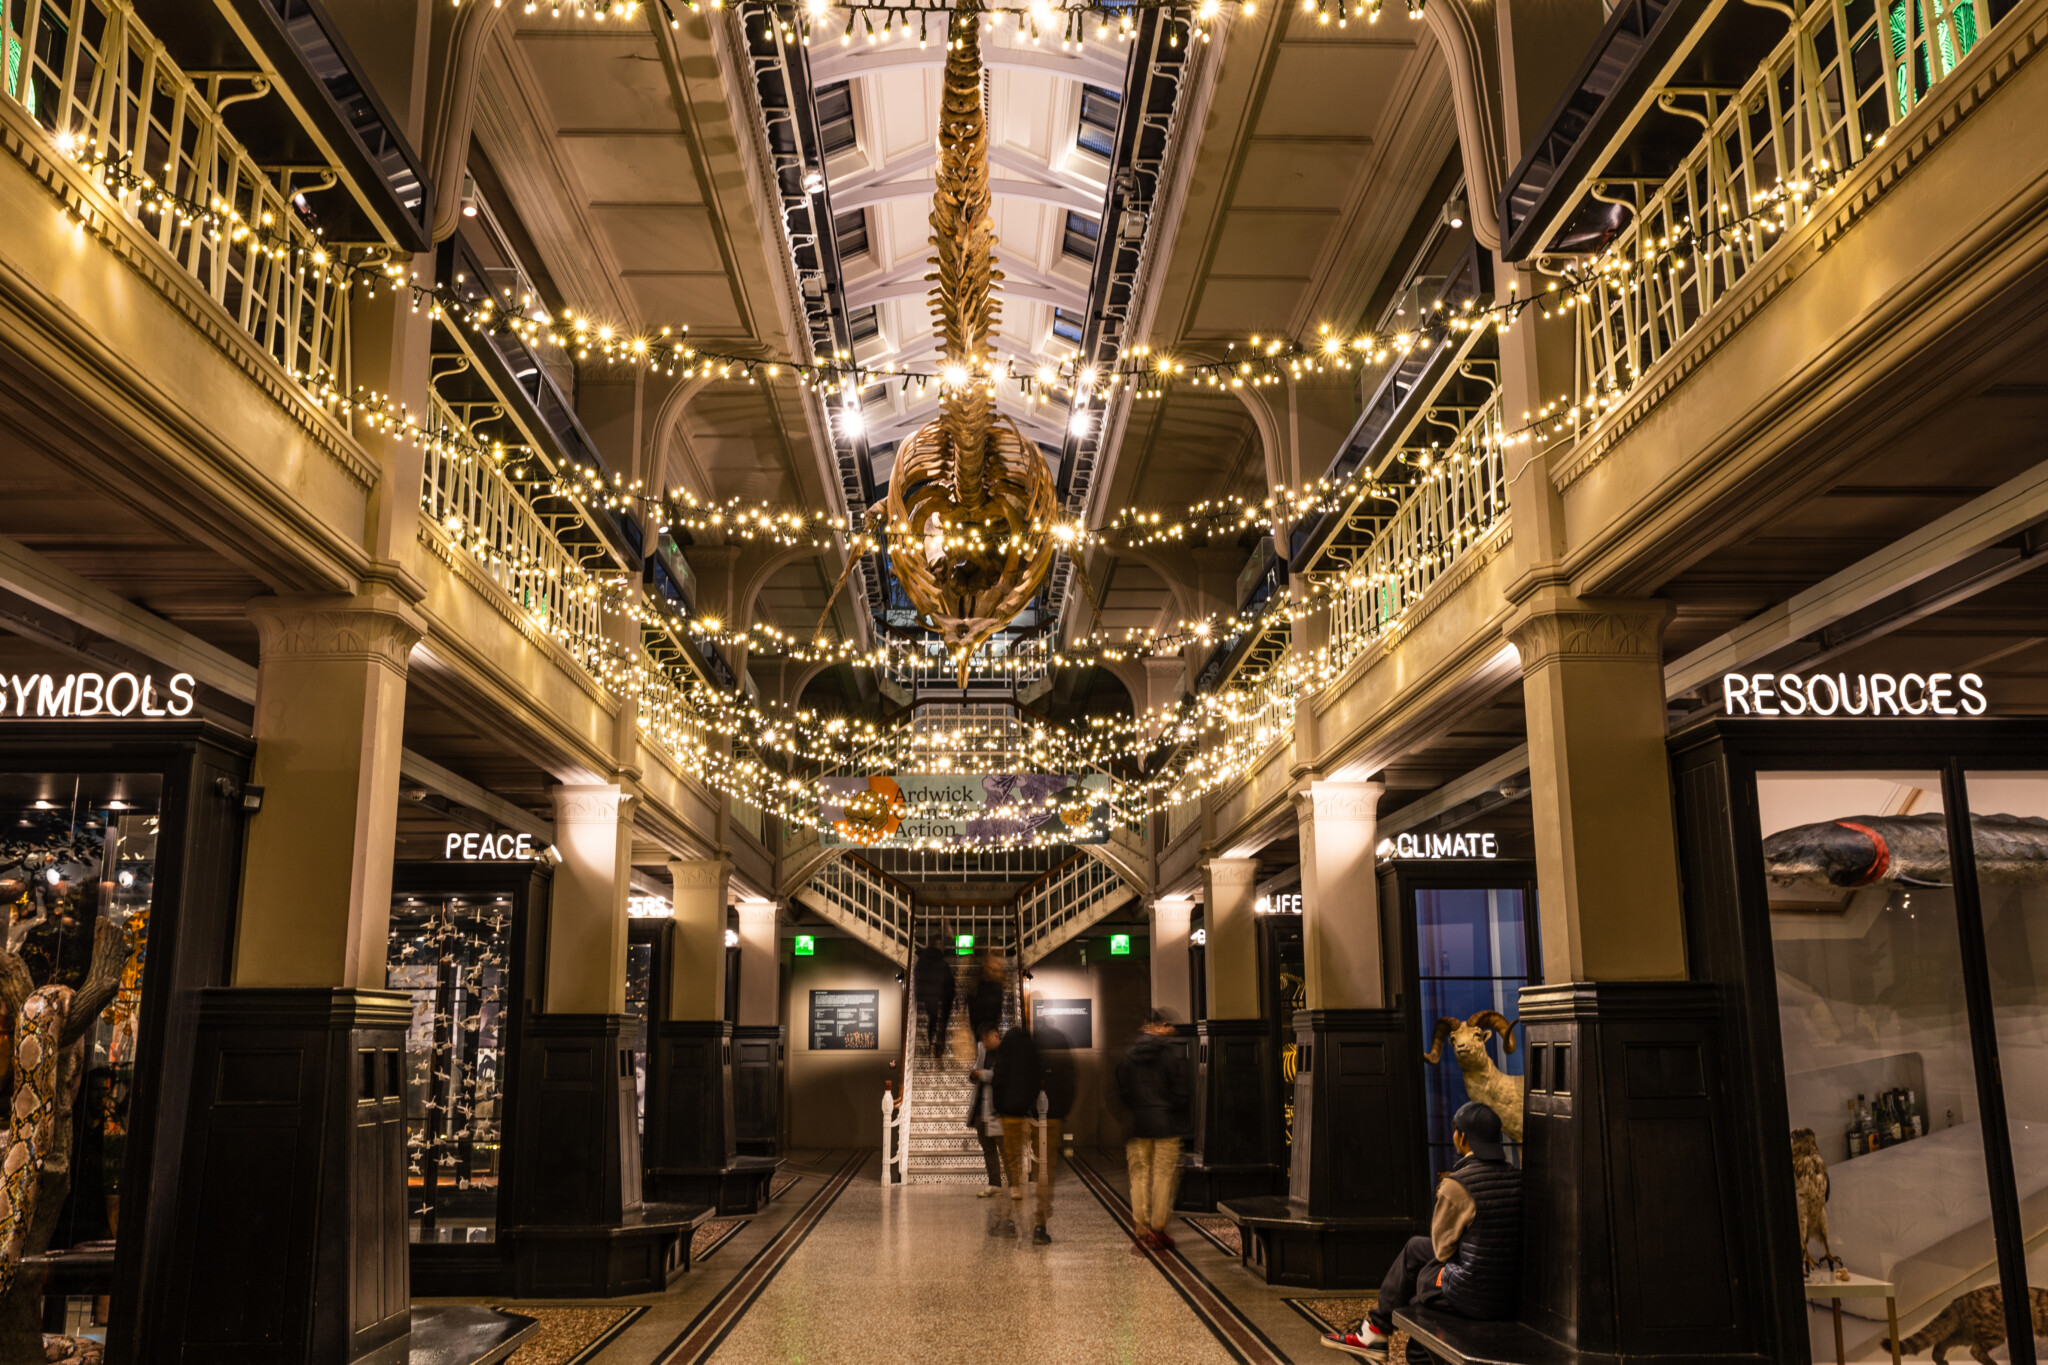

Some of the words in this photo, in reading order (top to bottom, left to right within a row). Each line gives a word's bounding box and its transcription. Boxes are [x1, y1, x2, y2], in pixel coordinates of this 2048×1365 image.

[0, 672, 196, 717] YMBOLS
[1723, 672, 1987, 716] RESOURCES
[893, 786, 974, 803] Ardwick
[893, 803, 966, 820] Climte
[894, 821, 956, 837] Action
[445, 833, 532, 860] PEACE
[1397, 833, 1496, 859] CLIMATE
[627, 896, 669, 918] ERS
[1266, 894, 1303, 914] LIFE
